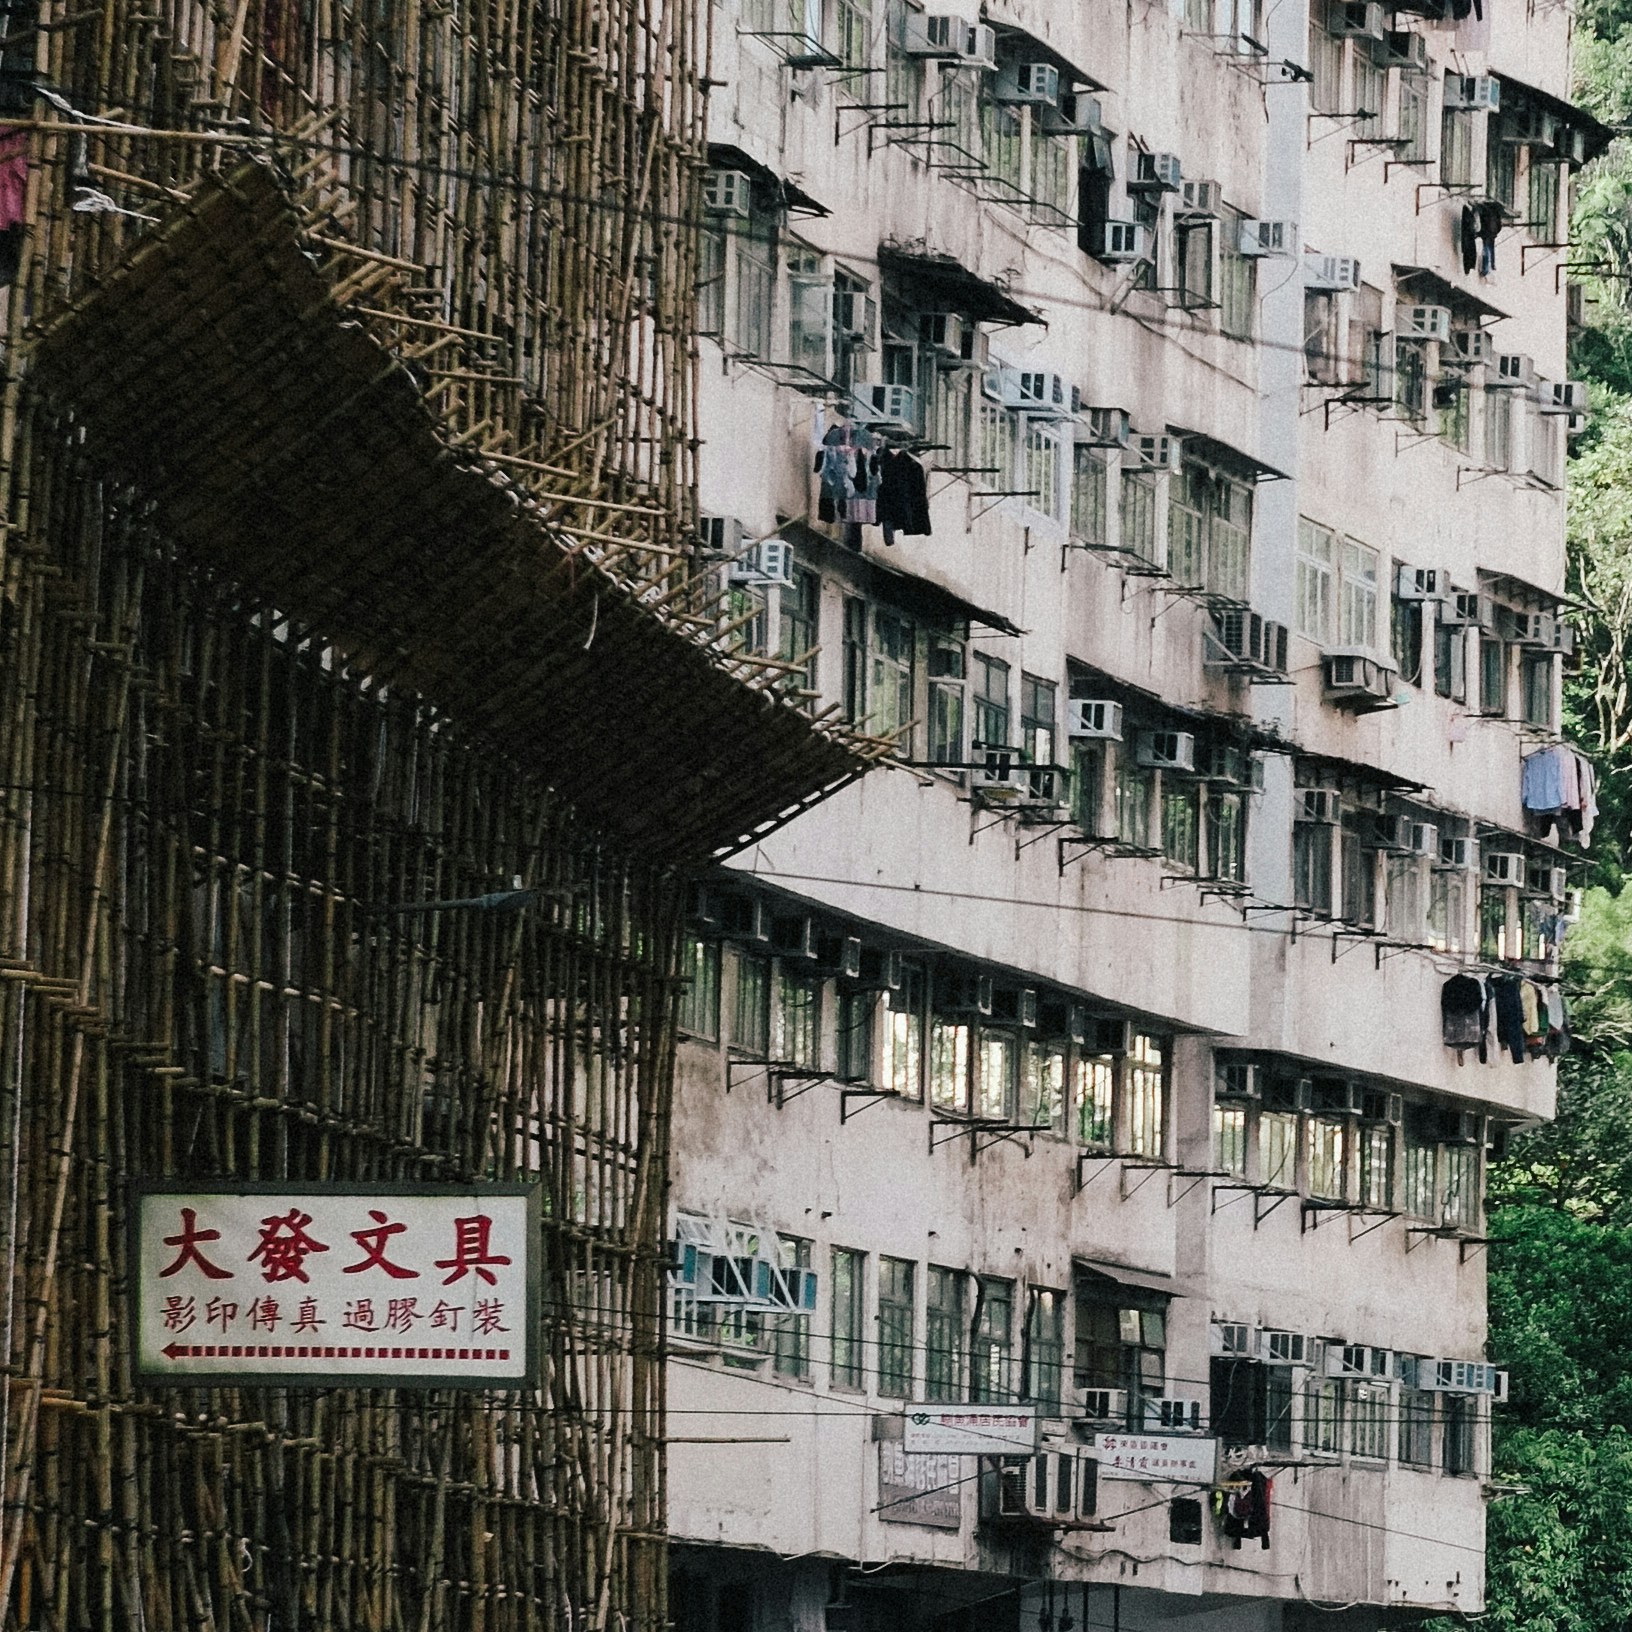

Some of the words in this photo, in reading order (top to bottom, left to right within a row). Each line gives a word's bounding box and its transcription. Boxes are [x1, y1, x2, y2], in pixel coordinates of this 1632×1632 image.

[158, 1207, 512, 1287] 大發文具
[159, 1294, 329, 1335] 影印傳真
[342, 1296, 512, 1336] 過膠釘裝
